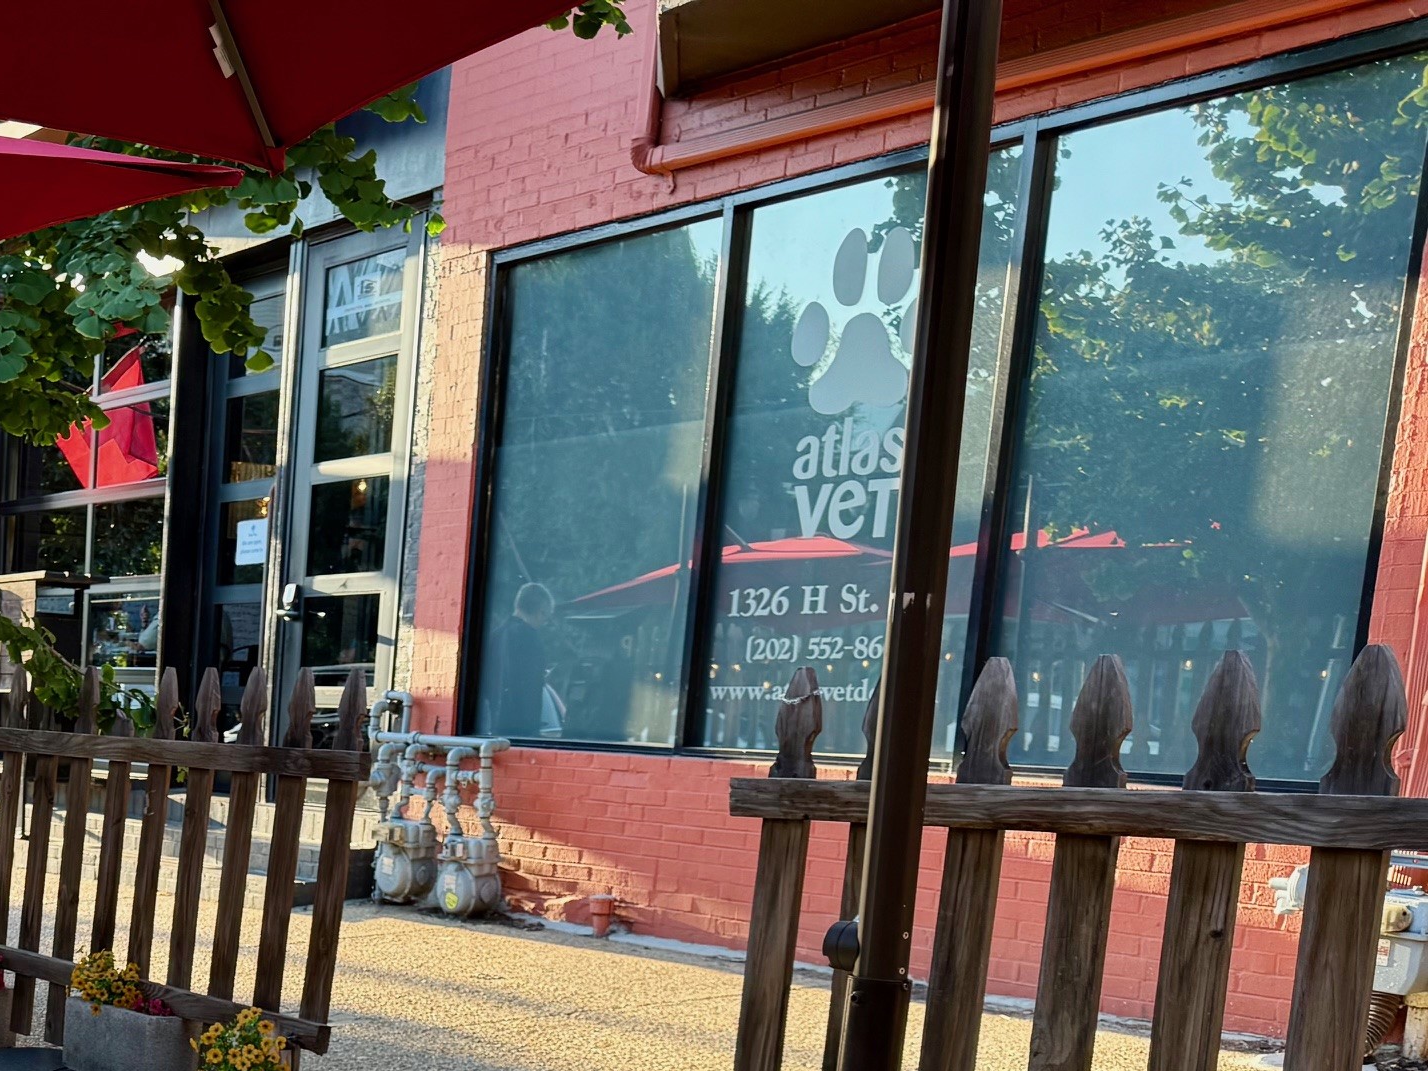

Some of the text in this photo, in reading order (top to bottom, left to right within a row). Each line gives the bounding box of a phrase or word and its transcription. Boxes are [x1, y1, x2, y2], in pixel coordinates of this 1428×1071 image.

[793, 417, 906, 480] atlas
[728, 583, 879, 618] 1326 H St.
[745, 634, 799, 664] (202)
